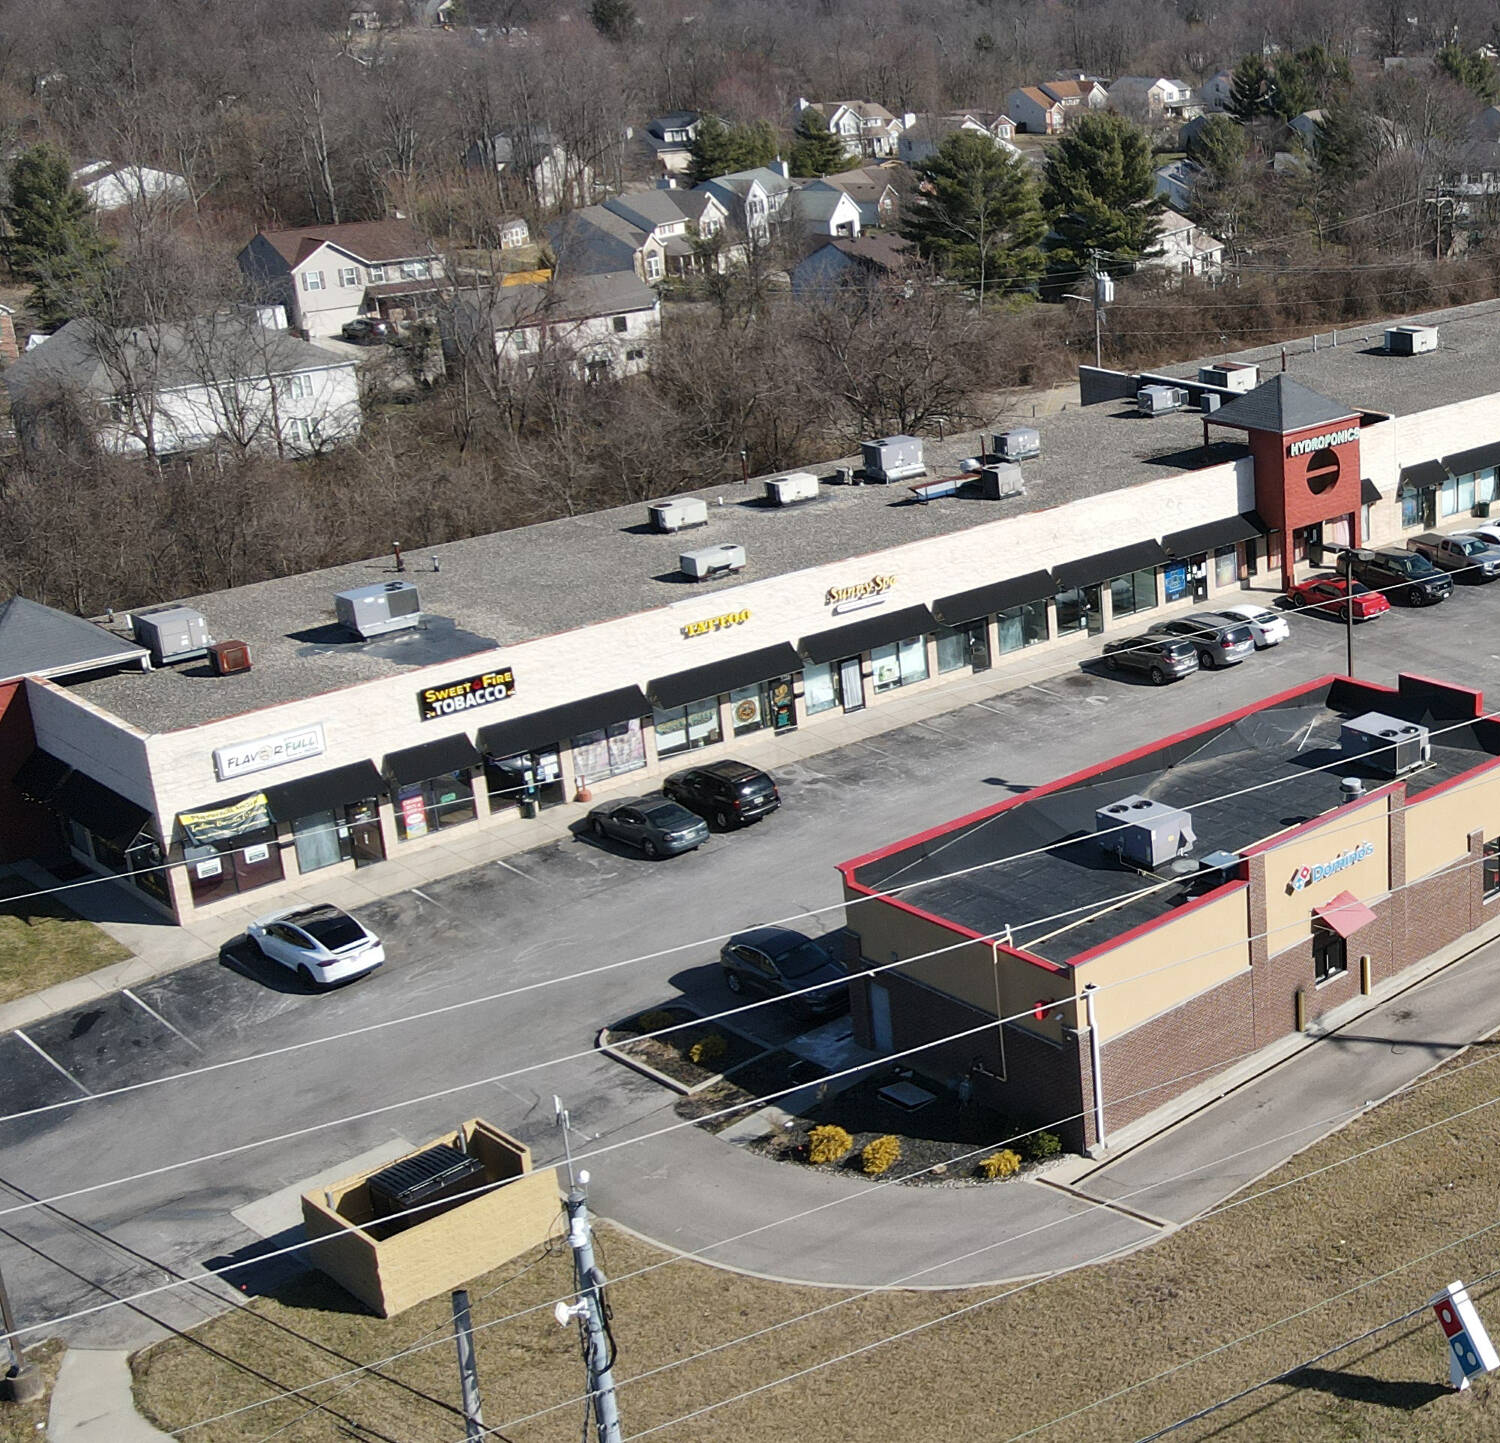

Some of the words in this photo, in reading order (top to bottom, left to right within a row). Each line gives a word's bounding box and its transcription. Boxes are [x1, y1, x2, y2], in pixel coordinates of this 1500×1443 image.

[1290, 426, 1361, 457] HYDROPONICS
[432, 684, 507, 716] TOBACCO
[1313, 842, 1374, 883] Domino's
